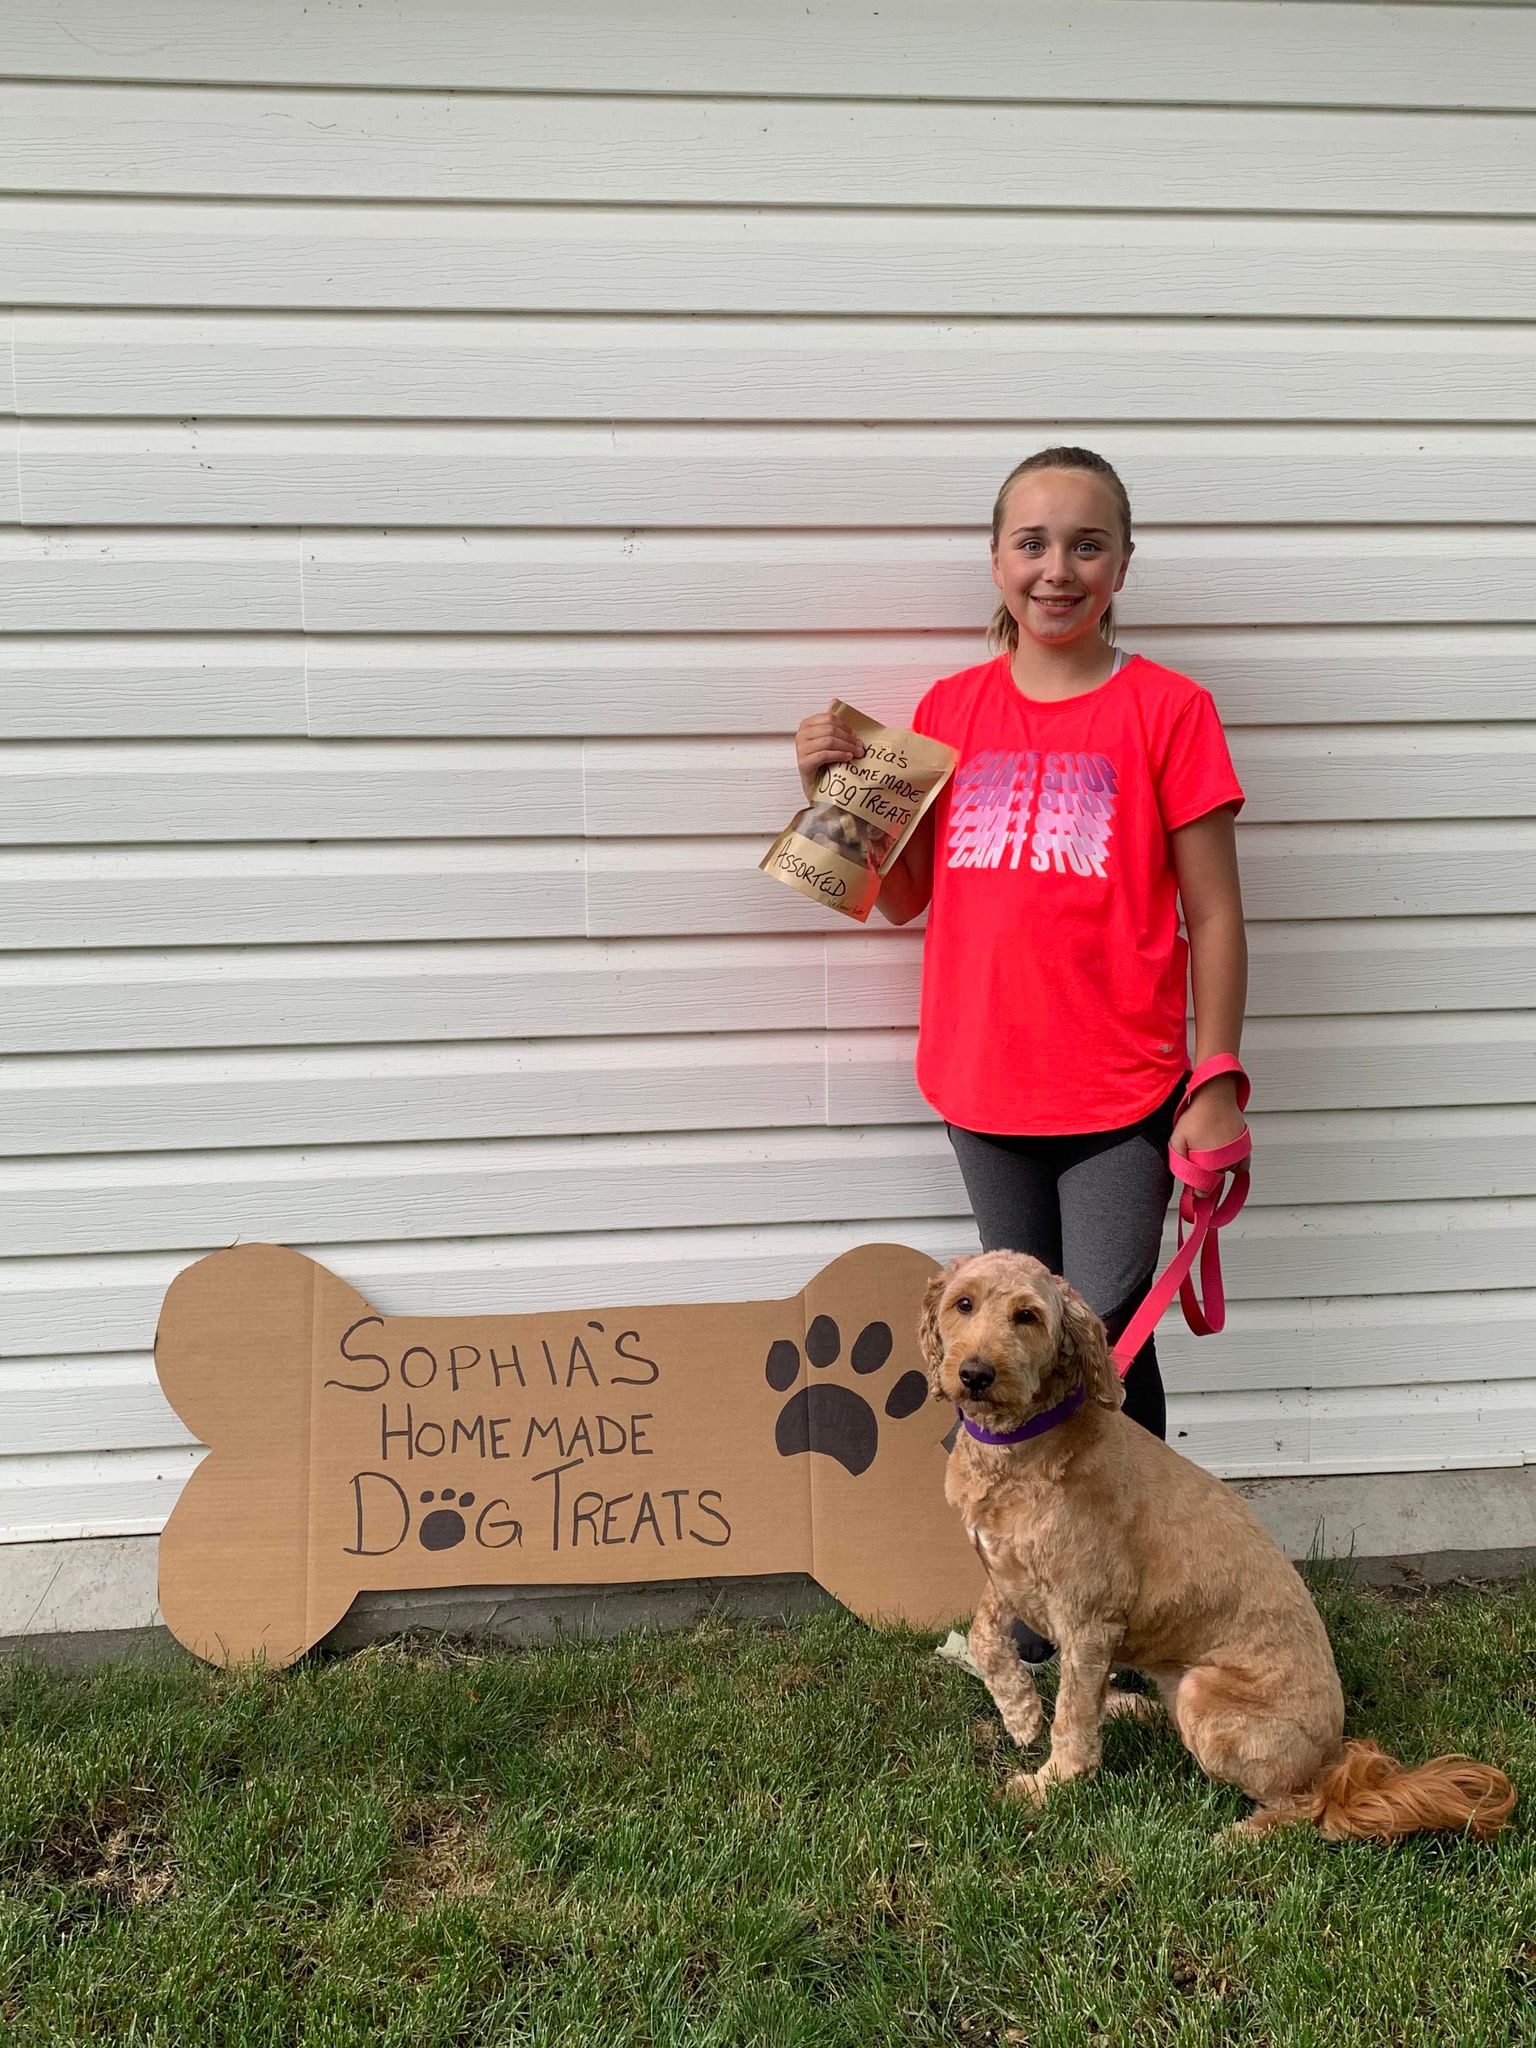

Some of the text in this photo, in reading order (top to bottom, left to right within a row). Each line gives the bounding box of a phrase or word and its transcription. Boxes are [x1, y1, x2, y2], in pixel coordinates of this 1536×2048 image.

[862, 744, 909, 769] hia's
[1044, 751, 1120, 796] STOP
[859, 786, 912, 826] TREATS
[773, 837, 847, 897] ASSORTED
[324, 1316, 660, 1392] SOPHIA'S
[531, 1458, 732, 1551] TREATS
